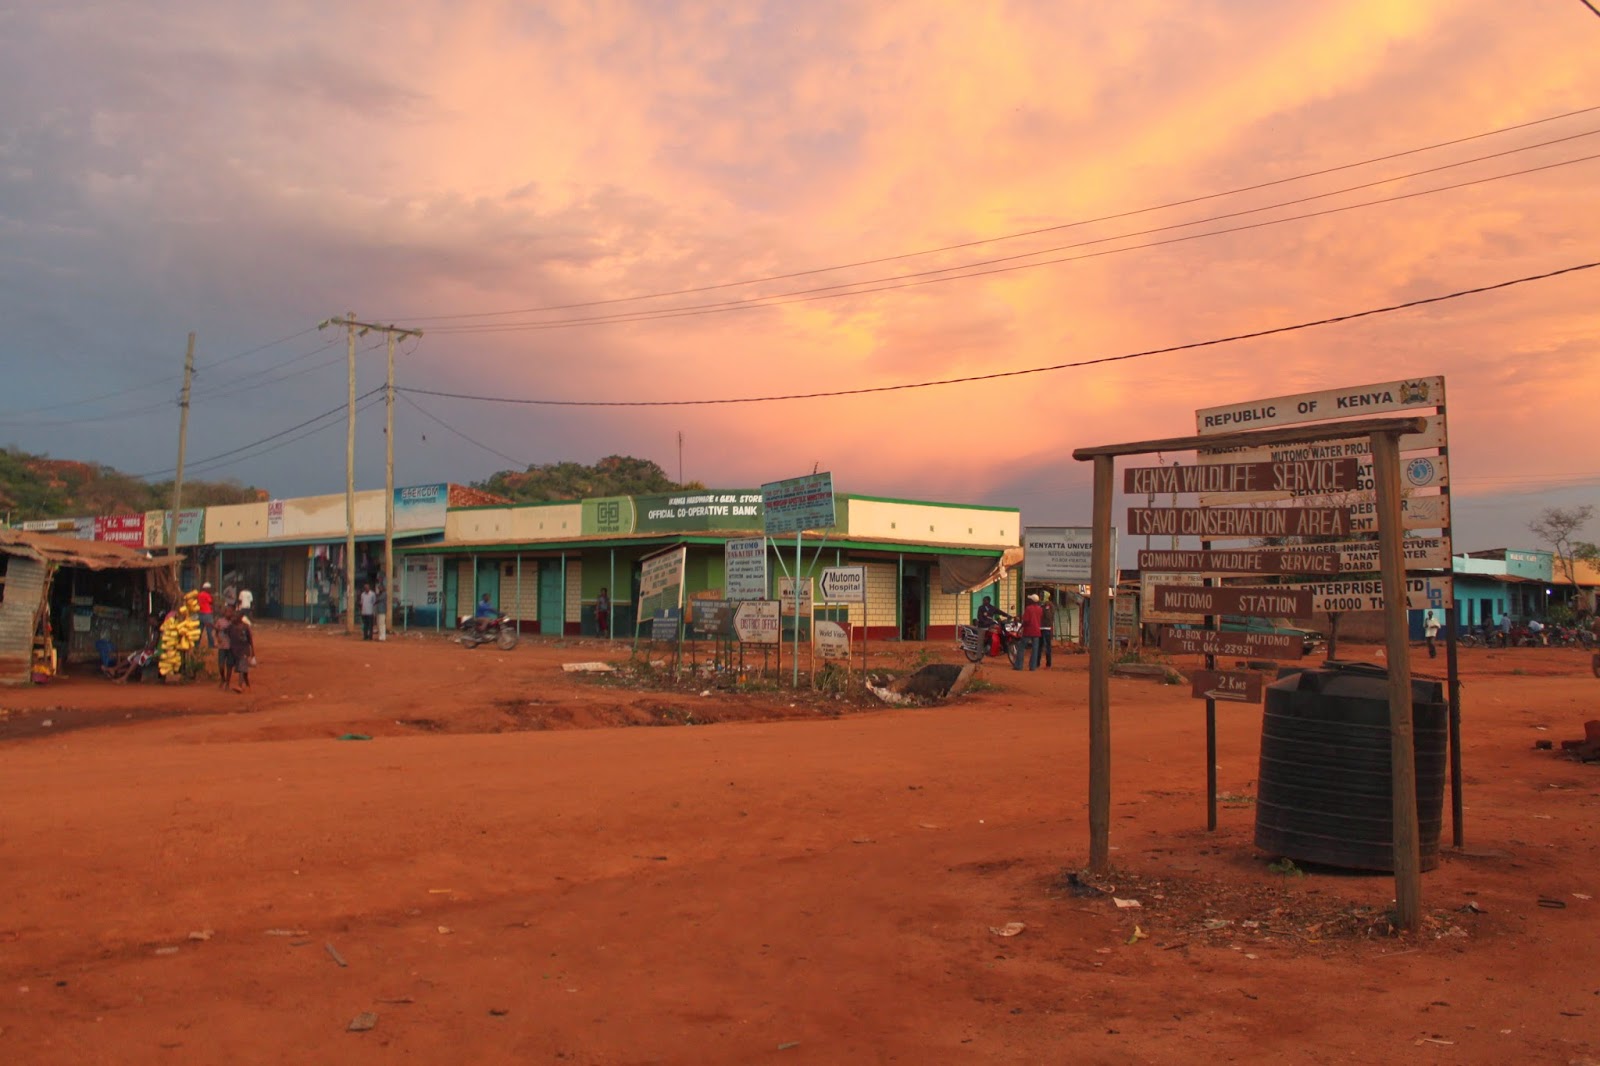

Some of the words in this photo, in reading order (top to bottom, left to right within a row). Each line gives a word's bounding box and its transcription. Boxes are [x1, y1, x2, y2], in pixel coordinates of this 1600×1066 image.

[1205, 406, 1276, 427] REPUBLIC
[1297, 401, 1317, 414] OF
[1337, 391, 1393, 408] KENYA
[1271, 449, 1309, 462] MUTOMO
[1312, 447, 1342, 459] WATER
[1345, 442, 1372, 455] PROJ
[1134, 468, 1179, 493] KENYA
[1183, 464, 1257, 492] WILDLIFE
[1273, 460, 1344, 491] SERVICE
[648, 509, 675, 519] OFFICIAL
[677, 506, 728, 517] CO-OPERATIVE
[733, 506, 757, 515] BANK
[1135, 509, 1176, 534] TSAVO
[1182, 509, 1286, 534] CONSERVATION
[1297, 509, 1342, 535] AREA
[1141, 553, 1205, 568] COMMUNITY
[1211, 554, 1262, 569] WILDLIFE
[1280, 555, 1332, 571] SERVICE
[1347, 553, 1379, 561] TANAT
[1340, 562, 1373, 570] BOARD
[829, 572, 860, 582] Mutomo
[1301, 581, 1382, 597] ENTERPRISE
[1406, 581, 1424, 592] TD
[1165, 592, 1212, 609] MUTOMO
[1239, 596, 1297, 613] STATION
[1324, 598, 1361, 610] 01000
[741, 619, 760, 630] DISTRICT
[762, 619, 777, 630] OFFICE
[1246, 634, 1290, 646] MUTOMO
[1219, 676, 1226, 689] 2
